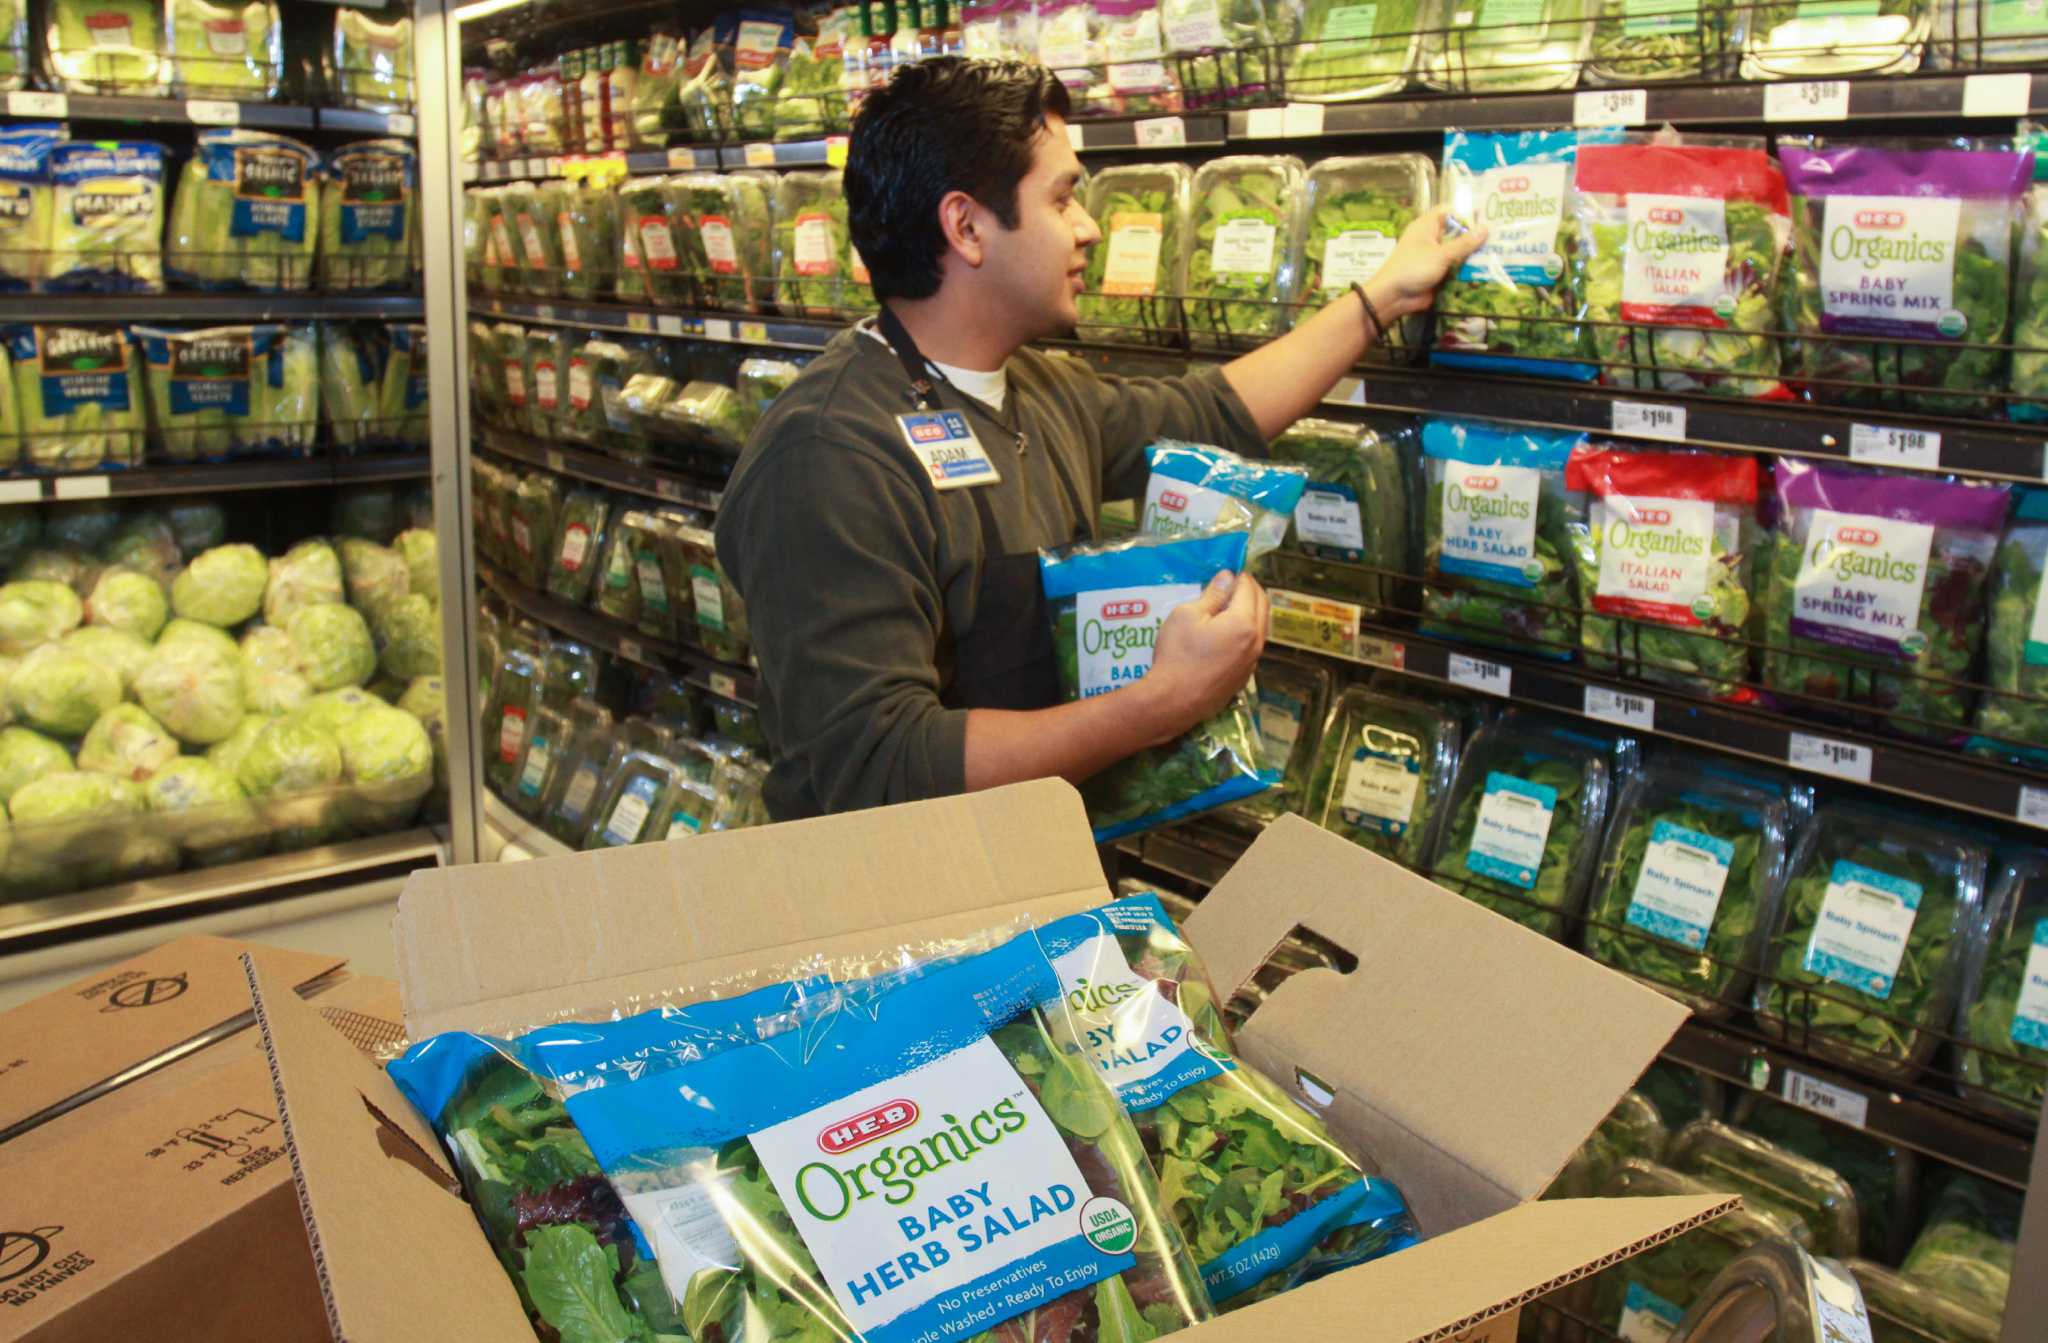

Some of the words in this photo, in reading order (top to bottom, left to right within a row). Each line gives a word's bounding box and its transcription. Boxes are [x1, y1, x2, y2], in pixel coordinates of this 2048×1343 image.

[1487, 192, 1556, 224] Organics
[1633, 218, 1722, 260] Organics
[1830, 225, 1946, 269] Organics
[1645, 265, 1701, 281] ITALIAN
[1860, 276, 1909, 290] BABY
[1829, 290, 1897, 308] SPRING
[1904, 296, 1942, 309] MIX
[1448, 483, 1530, 522] Organics
[1446, 536, 1478, 552] HERB
[1483, 541, 1527, 557] SALAD
[1468, 525, 1503, 540] BABY
[1610, 518, 1704, 558] Organics
[1620, 562, 1684, 581] ITALIAN
[1628, 578, 1670, 593] SALAD
[1802, 596, 1866, 620] SPRING
[1872, 610, 1906, 628] MIX
[1832, 586, 1878, 604] BABY
[1083, 617, 1162, 660] Organ
[1130, 1091, 1163, 1109] Ready
[1165, 1080, 1179, 1092] To
[1178, 1064, 1208, 1083] Enjoy
[237, 1145, 271, 1166] KEEP
[795, 1097, 1027, 1222] Organics
[898, 1180, 994, 1242] BABY
[1089, 1207, 1121, 1227] USDA
[846, 1240, 951, 1307] HERB
[956, 1183, 1076, 1254] SALAD
[1094, 1222, 1132, 1243] ORGANIC
[17, 1268, 52, 1290] NOT
[53, 1250, 86, 1269] CUT
[1227, 1263, 1236, 1279] 5
[1235, 1257, 1251, 1275] OZ
[1251, 1241, 1281, 1268] (142g)
[8, 1290, 37, 1307] NO
[35, 1258, 96, 1292] KNIVES
[938, 1297, 961, 1315] No
[961, 1259, 1048, 1305] Preservatives
[939, 1301, 996, 1337] Washed
[1005, 1281, 1047, 1307] Ready
[1046, 1275, 1064, 1291] To
[1064, 1260, 1100, 1284] Enjoy
